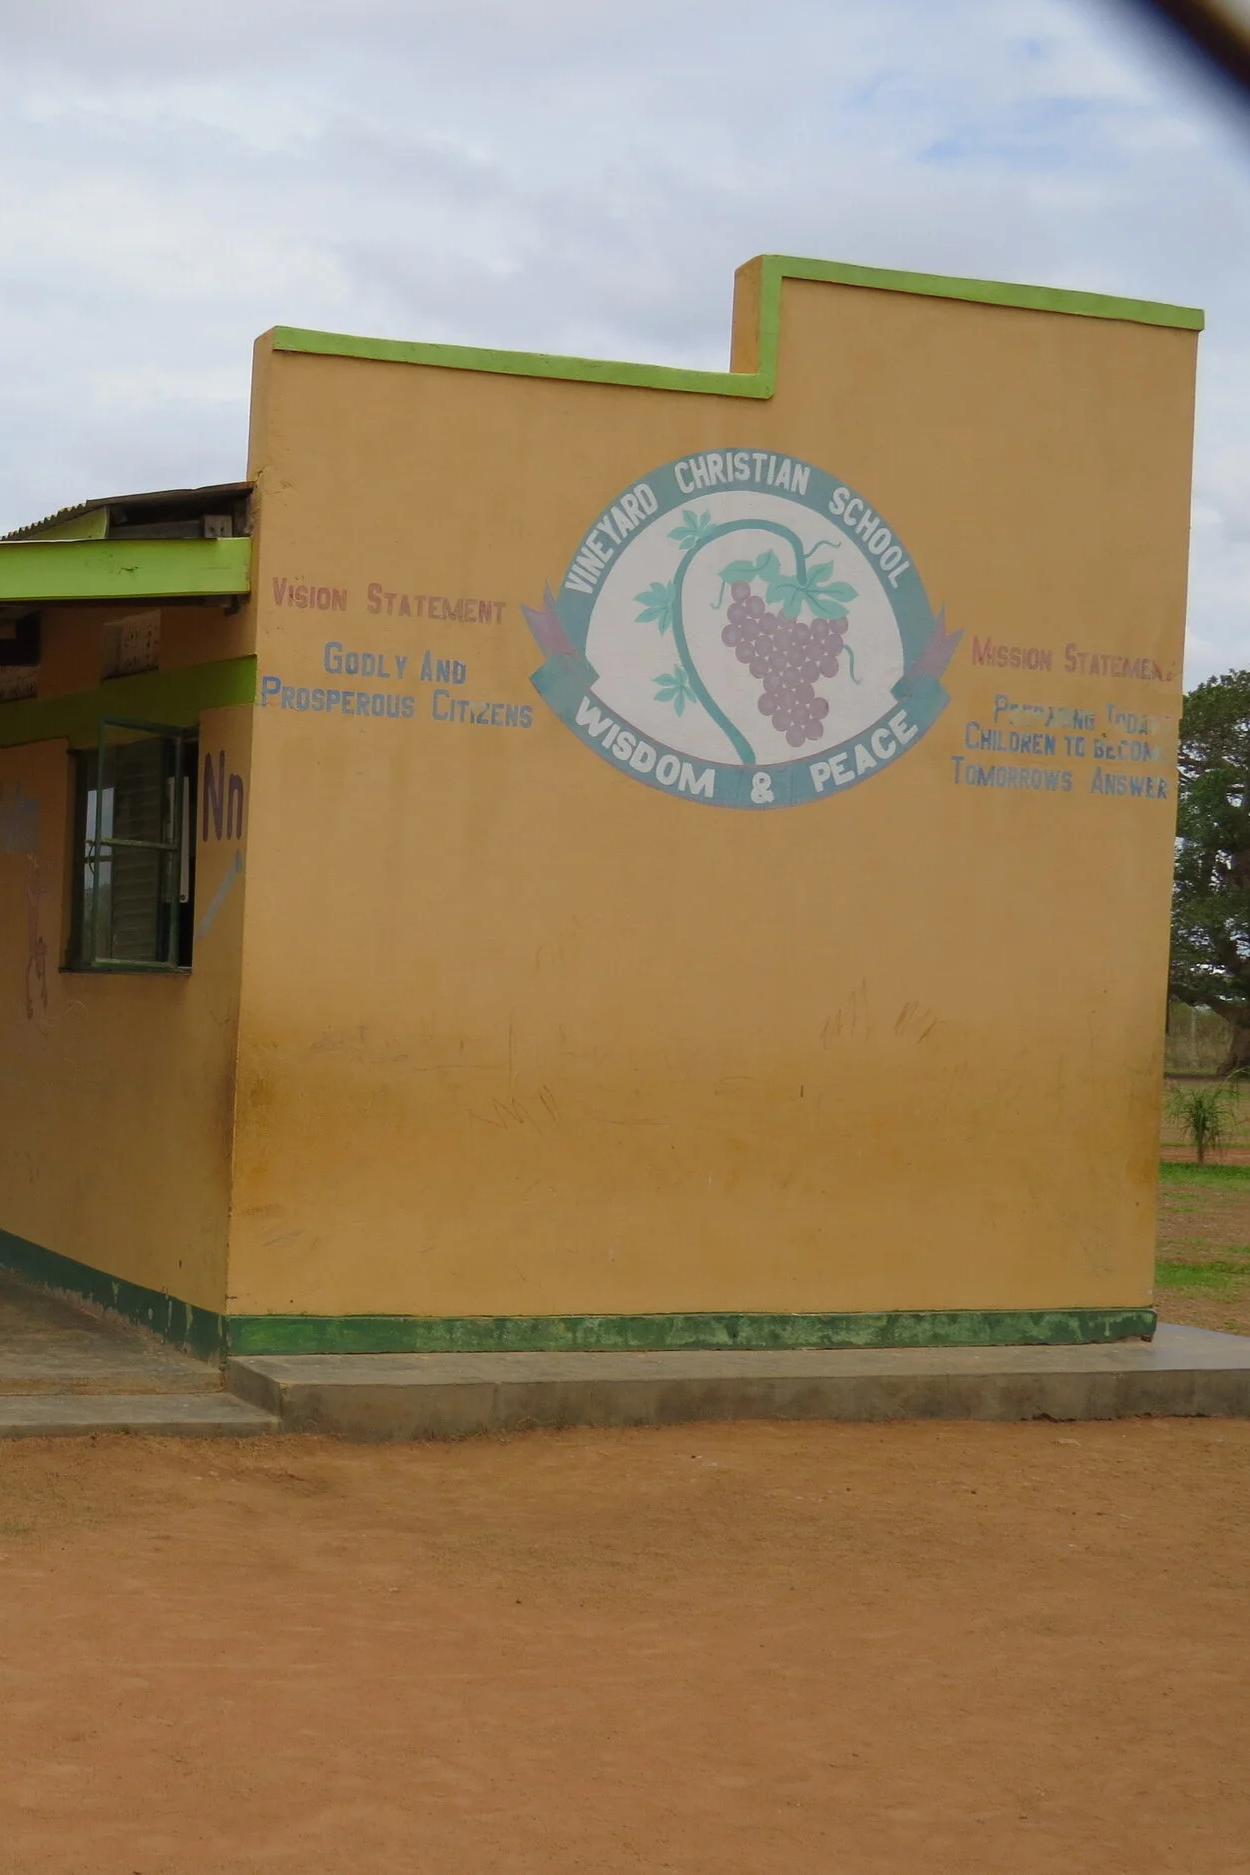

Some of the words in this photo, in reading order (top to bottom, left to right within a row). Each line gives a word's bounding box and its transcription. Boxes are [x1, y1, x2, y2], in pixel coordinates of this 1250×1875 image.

[565, 483, 659, 594] VINEYARD
[674, 452, 811, 495] CHRISTIAN
[828, 487, 911, 588] SCHOOL
[203, 749, 244, 843] Nn
[574, 696, 716, 798] WISDOM
[751, 772, 775, 803] &
[810, 709, 919, 792] PEACE
